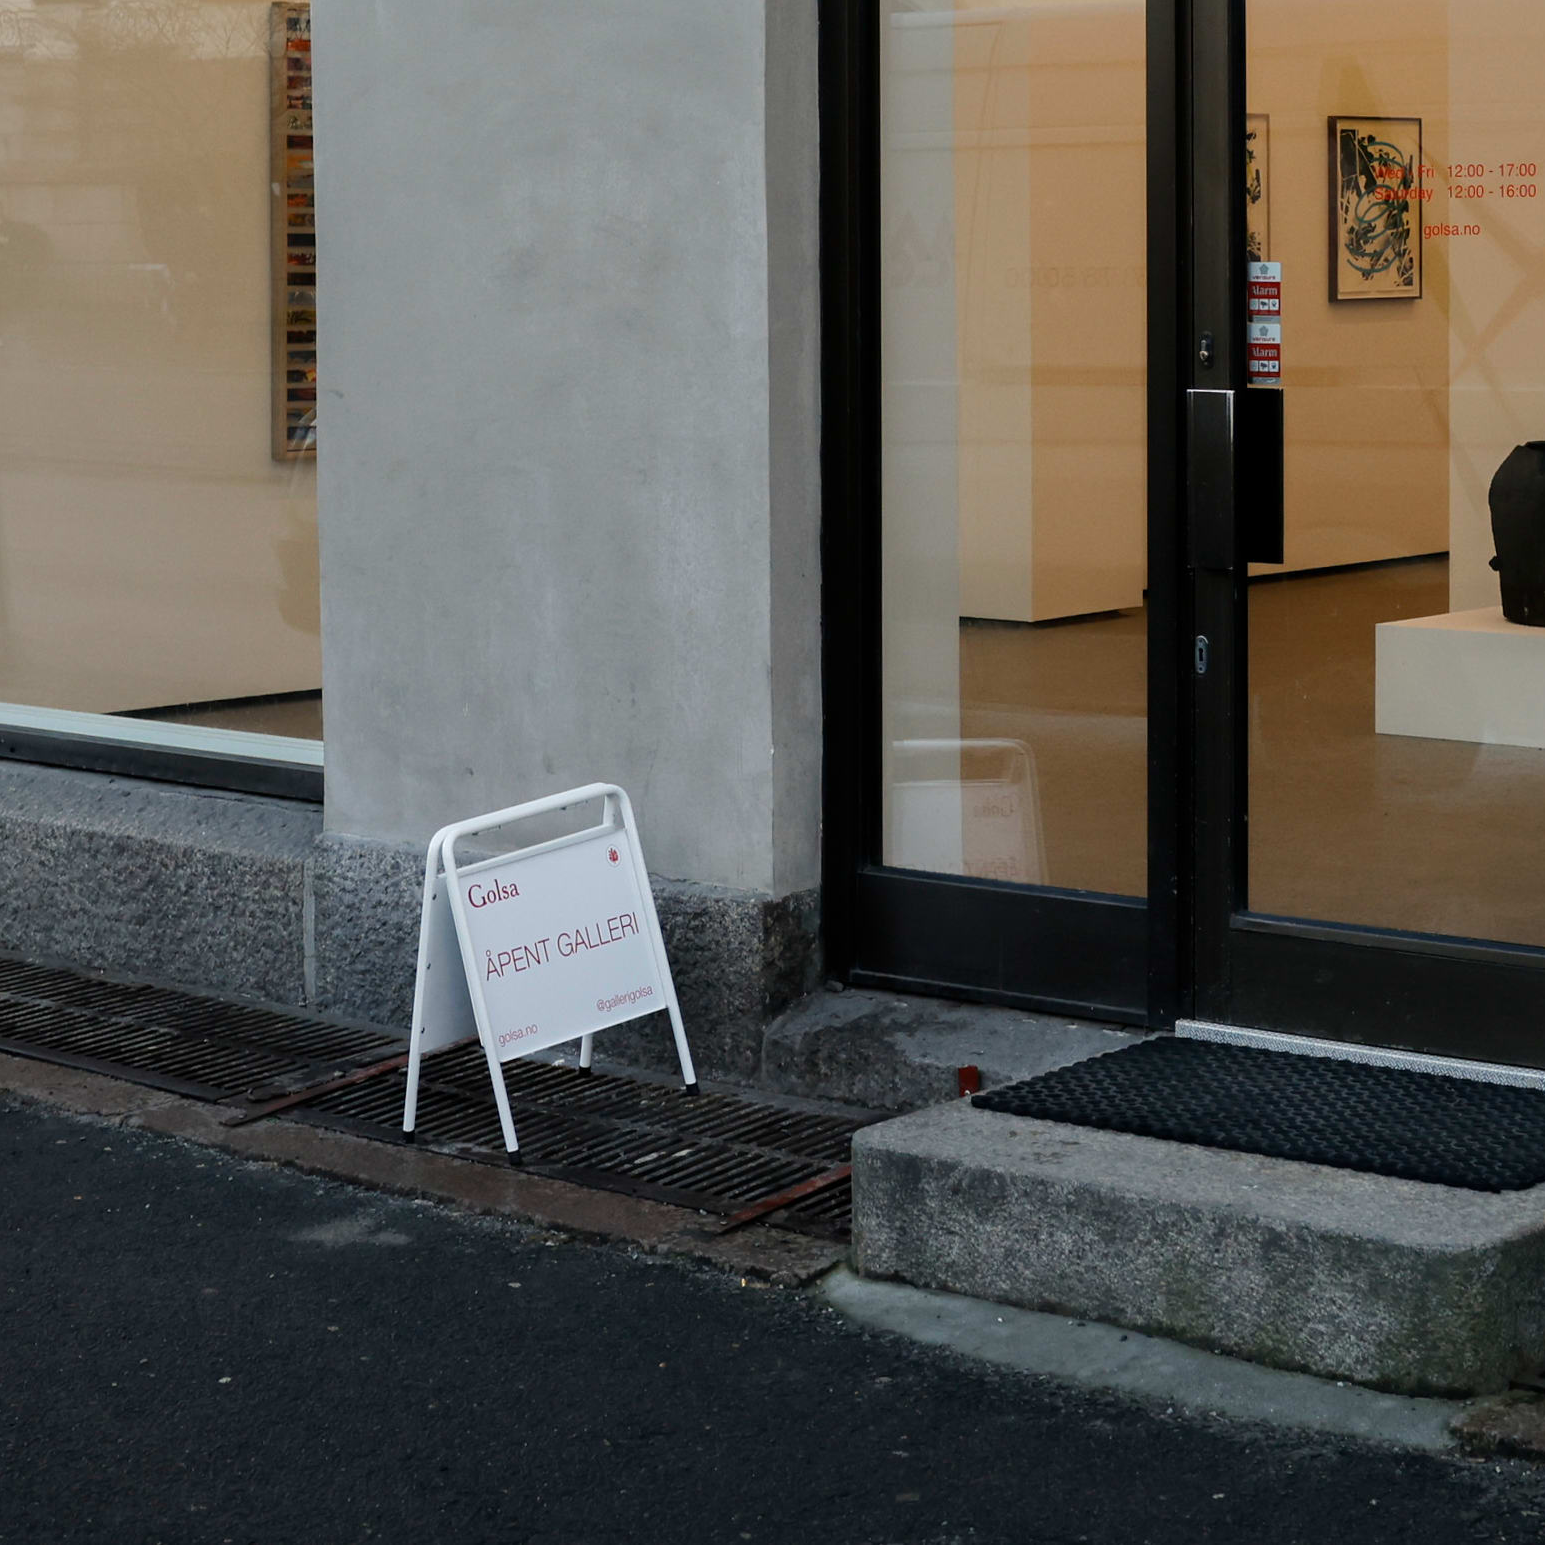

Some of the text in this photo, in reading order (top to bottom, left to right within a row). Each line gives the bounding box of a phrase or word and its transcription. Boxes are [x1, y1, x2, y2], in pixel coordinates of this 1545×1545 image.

[1374, 166, 1404, 179] Wed
[1417, 164, 1435, 178] Fri
[1448, 163, 1484, 178] 12:00
[1499, 163, 1537, 177] 17:00
[1374, 186, 1434, 202] Saturday
[1448, 185, 1484, 198] 12:00
[1499, 184, 1537, 198] 16:00
[1423, 223, 1481, 239] golsa.no
[468, 879, 520, 909] Golsa
[486, 912, 640, 981] ÅPENT GALLERI
[596, 985, 653, 1012] @gallerigolsa
[498, 1023, 538, 1047] golsa.no
